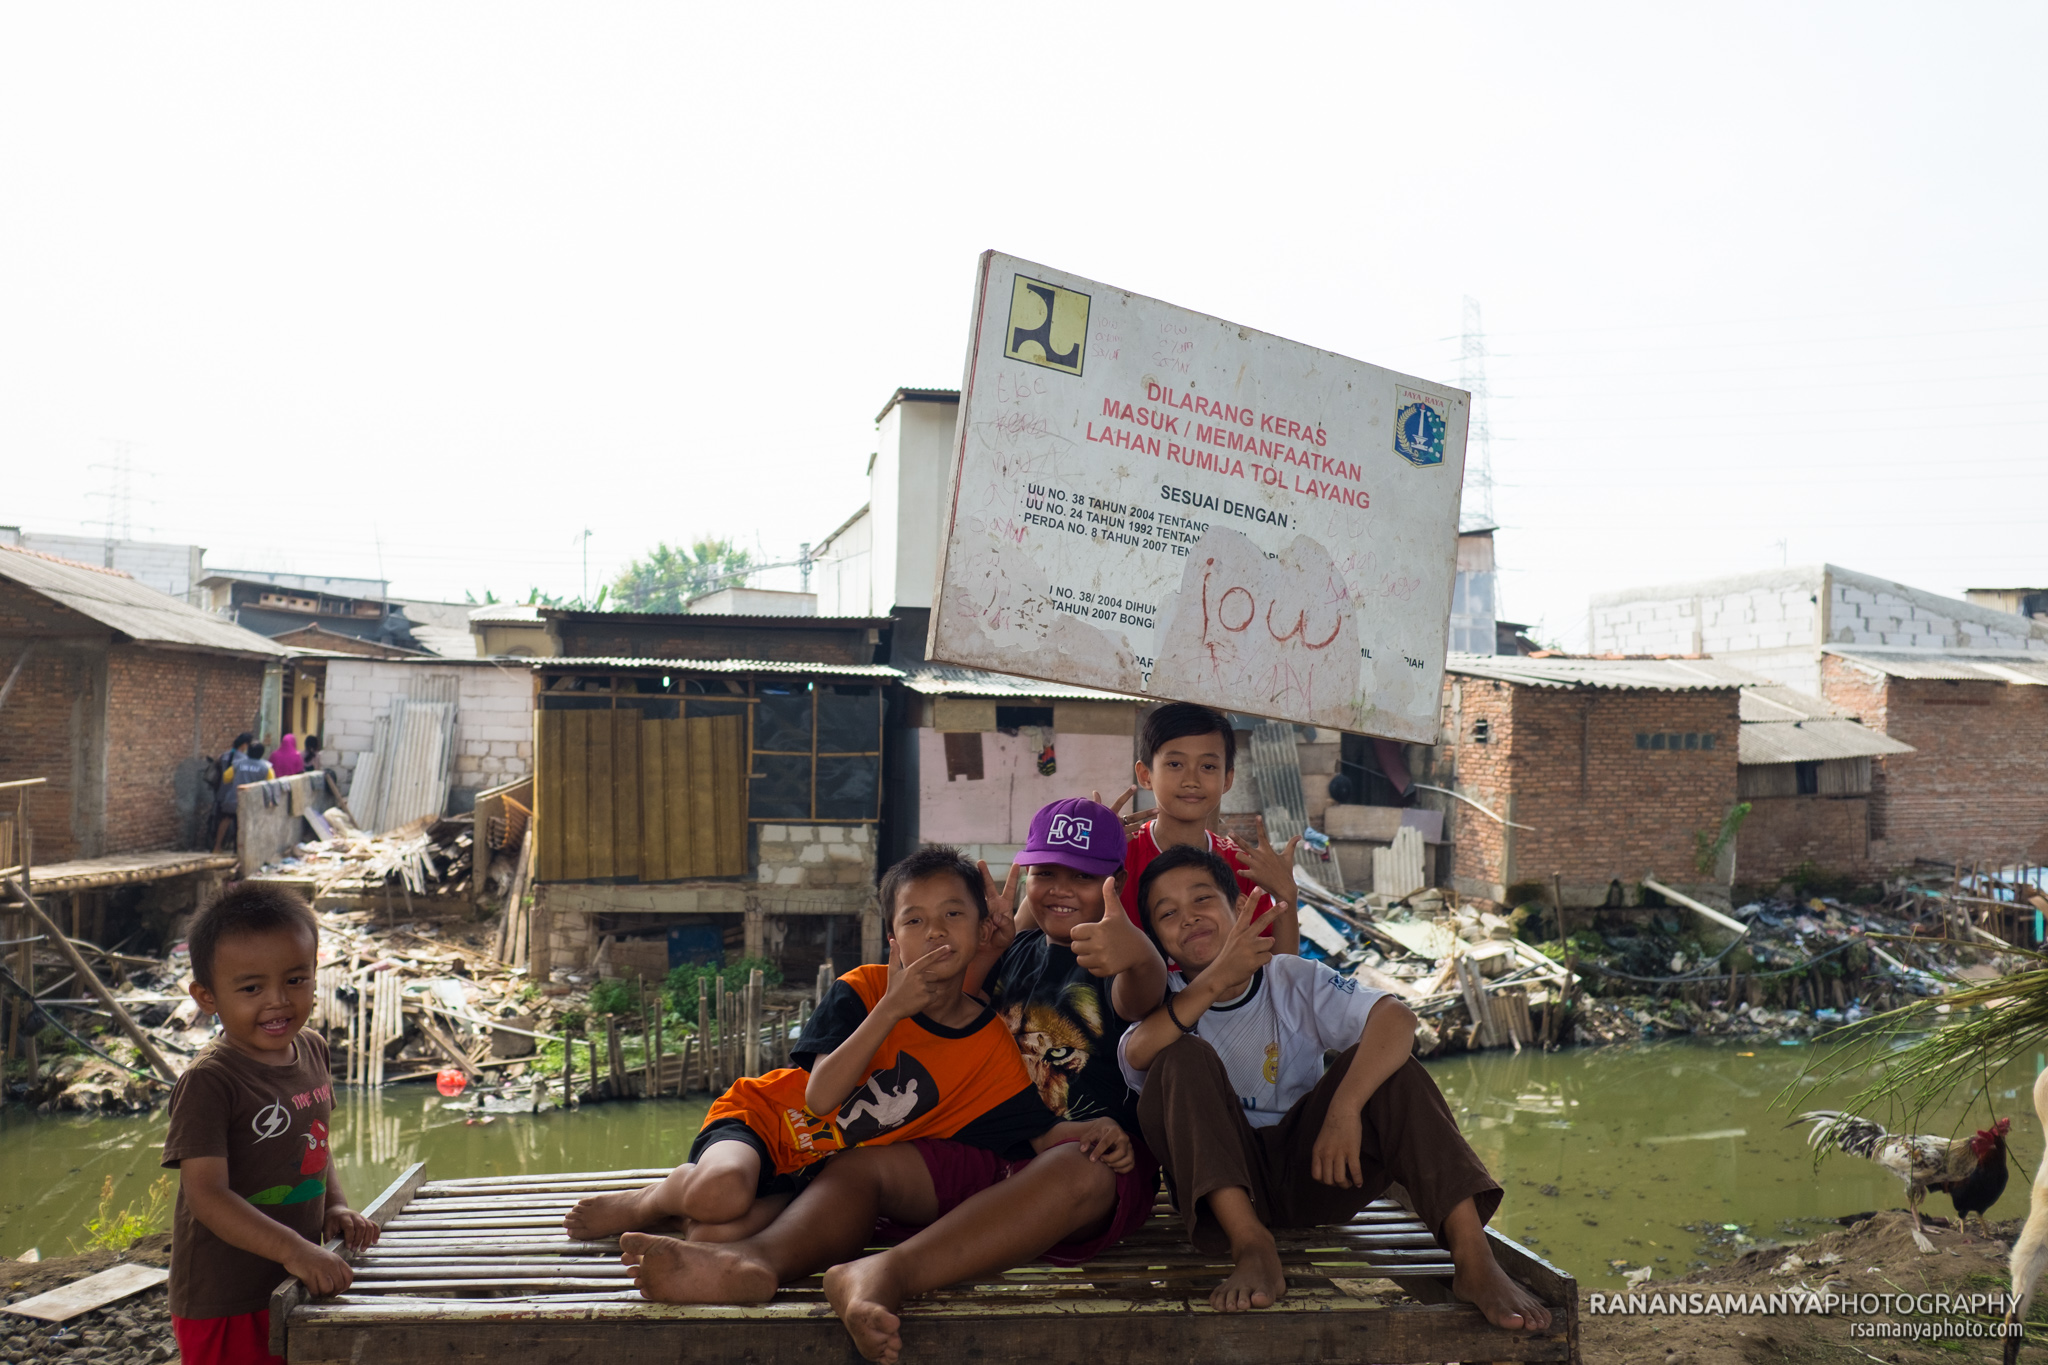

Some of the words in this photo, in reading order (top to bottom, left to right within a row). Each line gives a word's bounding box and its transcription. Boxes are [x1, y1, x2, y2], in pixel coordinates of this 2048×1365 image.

[1147, 382, 1254, 427] DILARANG
[1260, 413, 1327, 447] KERAS
[1402, 390, 1422, 401] JAYA
[1424, 396, 1444, 408] RAYA
[1102, 397, 1180, 435] MASUK
[1183, 420, 1192, 438] /
[1196, 423, 1362, 482] MEMANFAATKAN
[1086, 421, 1161, 457] LAHAN
[1167, 442, 1245, 479] RUMIJA
[1251, 463, 1289, 490] TOL
[1294, 475, 1370, 509] LAYANG
[1026, 498, 1043, 510] UU
[1046, 502, 1066, 516] NO.
[1069, 508, 1083, 520] 24
[1086, 511, 1125, 529] TAHUN
[1128, 521, 1153, 536] 1992
[1028, 483, 1045, 496] UU
[1048, 488, 1068, 502] NO.
[1071, 493, 1085, 505] 38
[1088, 497, 1127, 515] TAHUN
[1130, 506, 1155, 521] 2004
[1158, 513, 1209, 533] TENTANG
[1160, 485, 1219, 511] SESUAI
[1223, 500, 1288, 528] DENGAN
[1024, 512, 1065, 531] PERDA
[1067, 522, 1088, 536] NO.
[1091, 527, 1098, 538] 8
[1101, 529, 1140, 547] TAHUN
[1142, 539, 1167, 553] 2007
[1051, 599, 1089, 617] TAHUN
[1091, 608, 1117, 621] 2007
[1055, 586, 1076, 600] NO.
[1079, 591, 1096, 603] 38/
[1097, 595, 1122, 609] 2004
